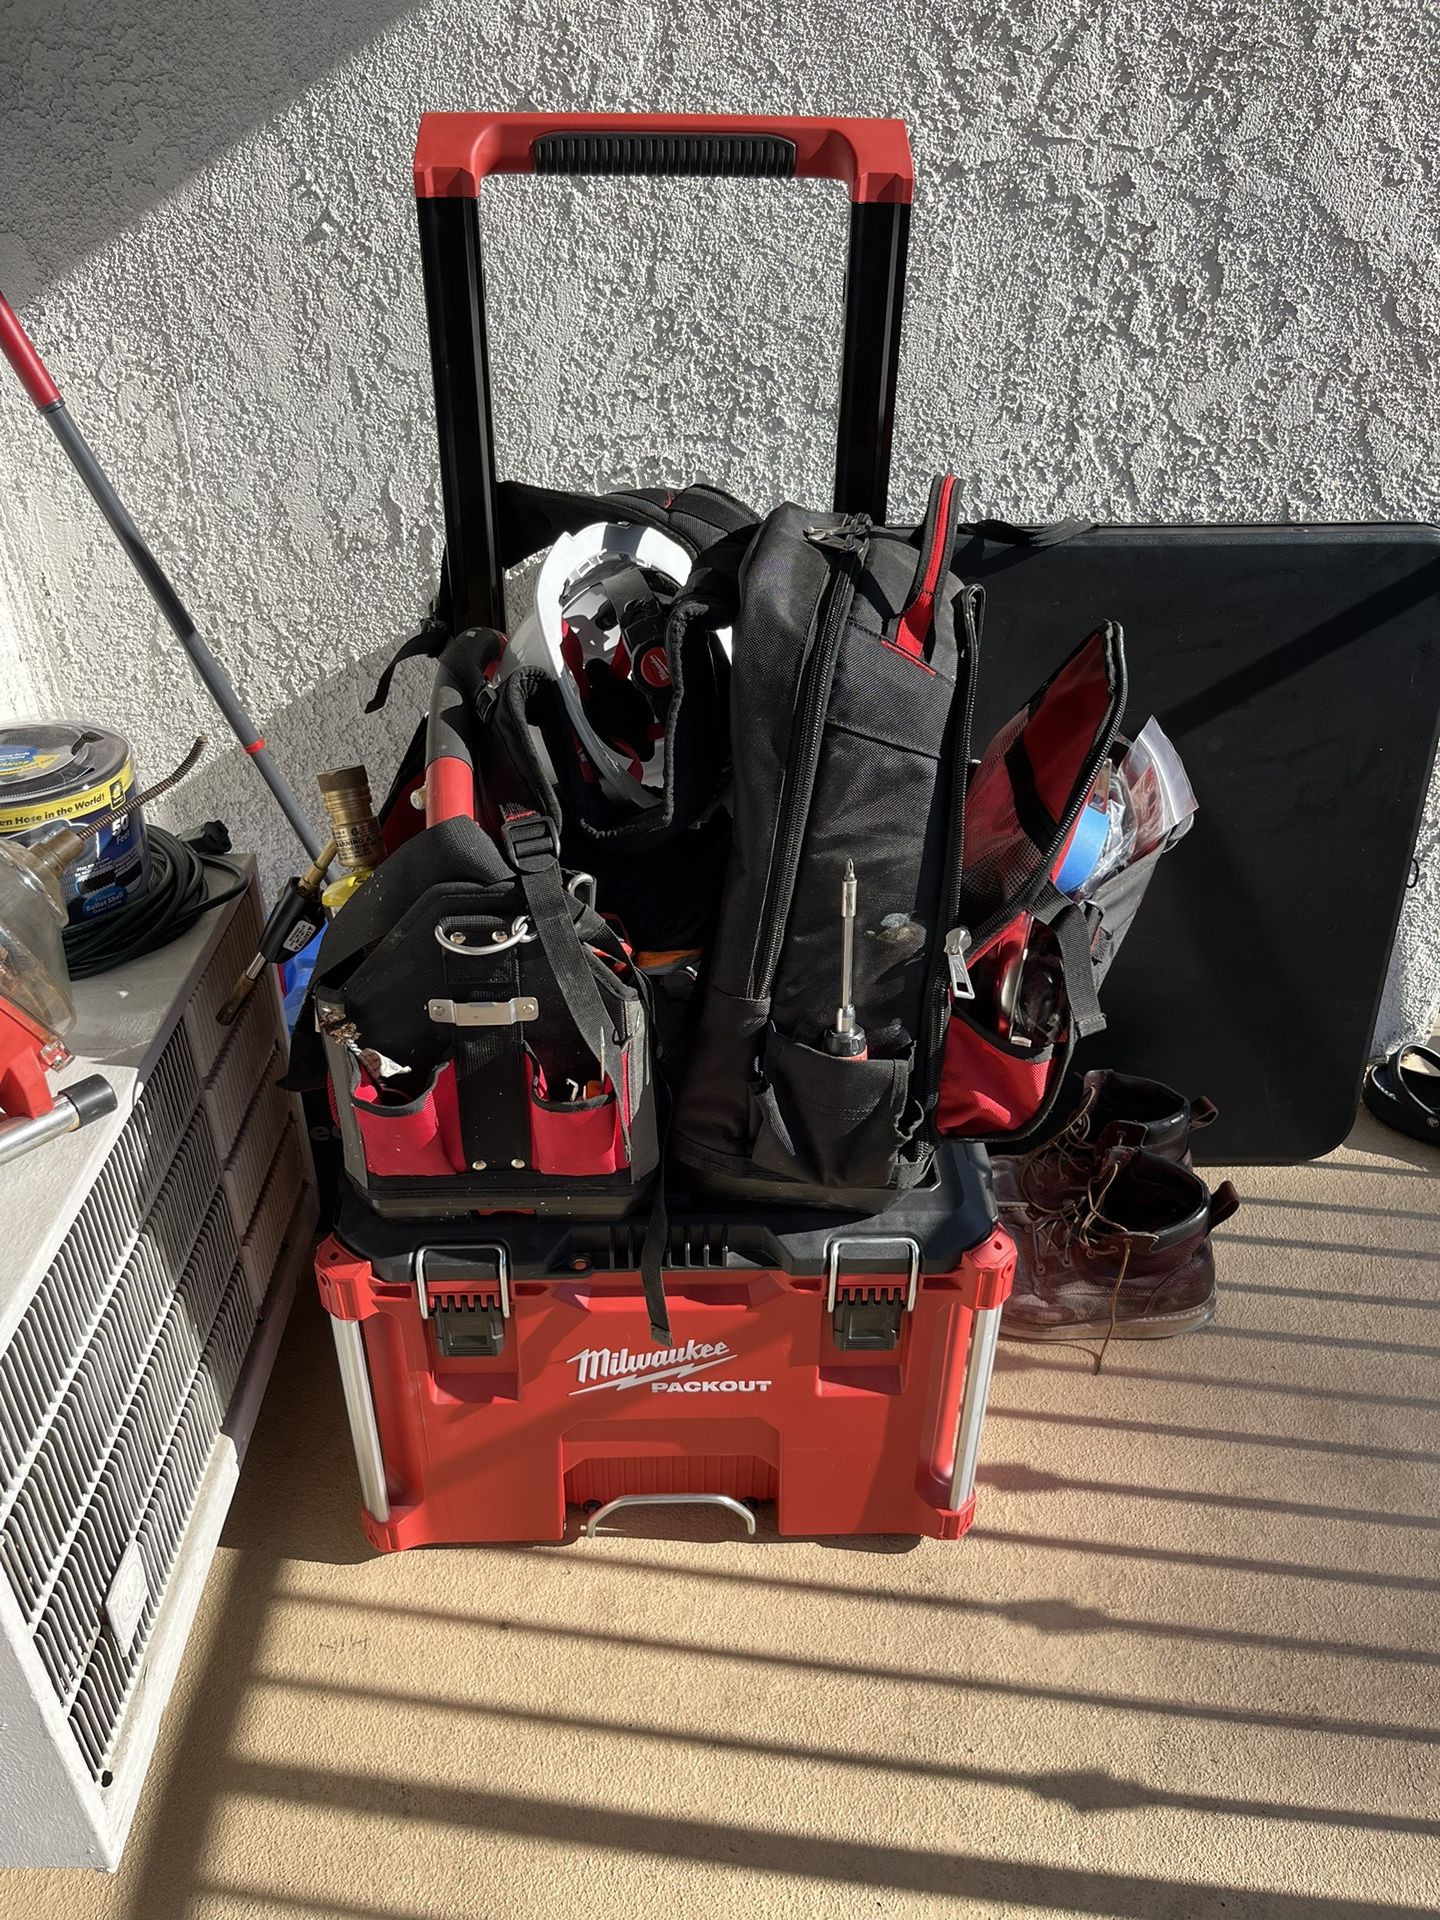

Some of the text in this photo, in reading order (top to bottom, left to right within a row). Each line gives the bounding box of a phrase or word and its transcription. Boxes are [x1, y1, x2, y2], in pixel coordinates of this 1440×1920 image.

[15, 815, 42, 825] Hose
[44, 811, 55, 820] in
[56, 806, 73, 817] the
[74, 793, 105, 811] World!
[112, 814, 129, 837] 50
[116, 830, 130, 845] Feet
[567, 1339, 730, 1383] Milwaukee
[651, 1380, 772, 1393] PACKOUT
